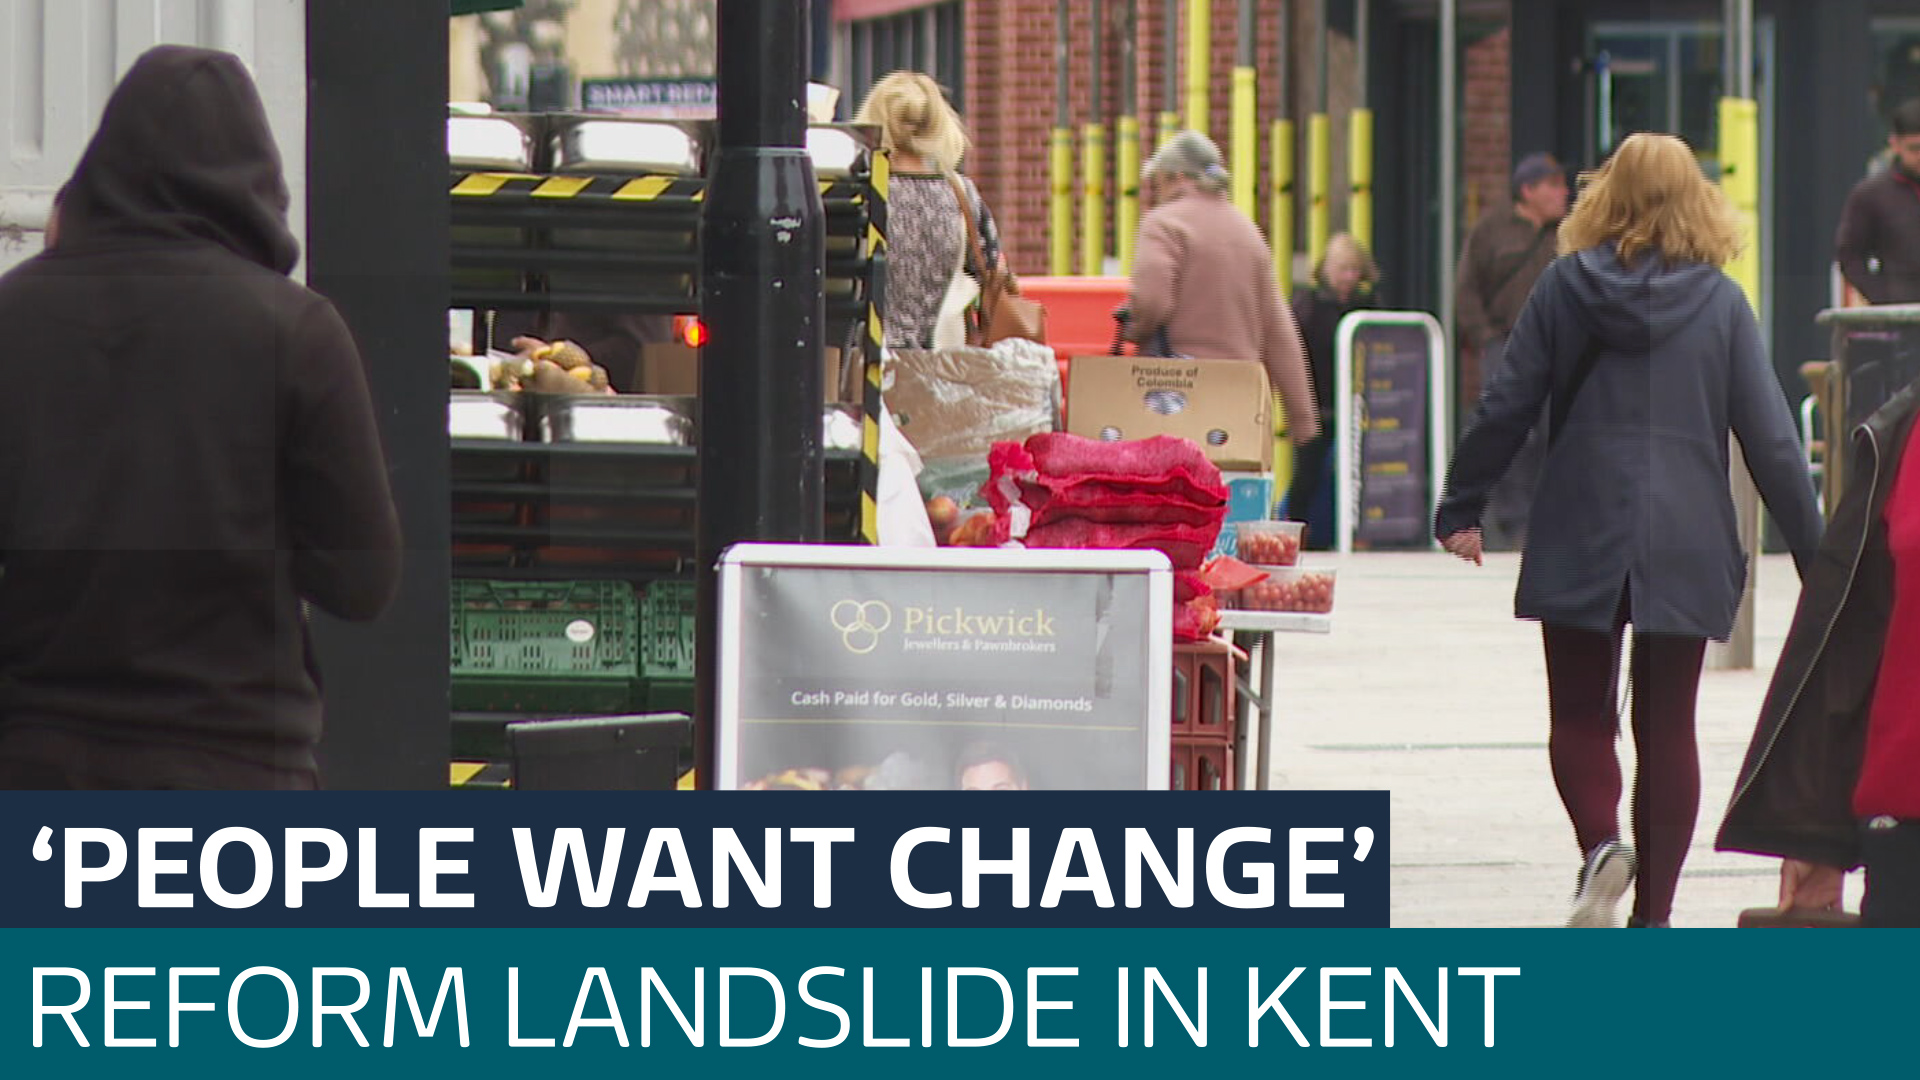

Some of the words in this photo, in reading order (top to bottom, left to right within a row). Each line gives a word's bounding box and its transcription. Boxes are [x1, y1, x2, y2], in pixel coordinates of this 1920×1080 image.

[1131, 364, 1183, 377] Produce
[1185, 366, 1199, 378] of
[1137, 376, 1194, 389] Colombia
[903, 606, 1055, 636] Pickwick
[903, 637, 960, 651] Jewellers
[961, 638, 972, 650] &
[974, 639, 1056, 653] Pawnbrokers
[790, 690, 831, 706] Cash
[834, 690, 870, 706] Paid
[873, 691, 896, 706] for
[900, 691, 942, 710] Gold,
[945, 692, 991, 708] Silver
[994, 694, 1008, 709] &
[1011, 694, 1093, 712] Diamonds
